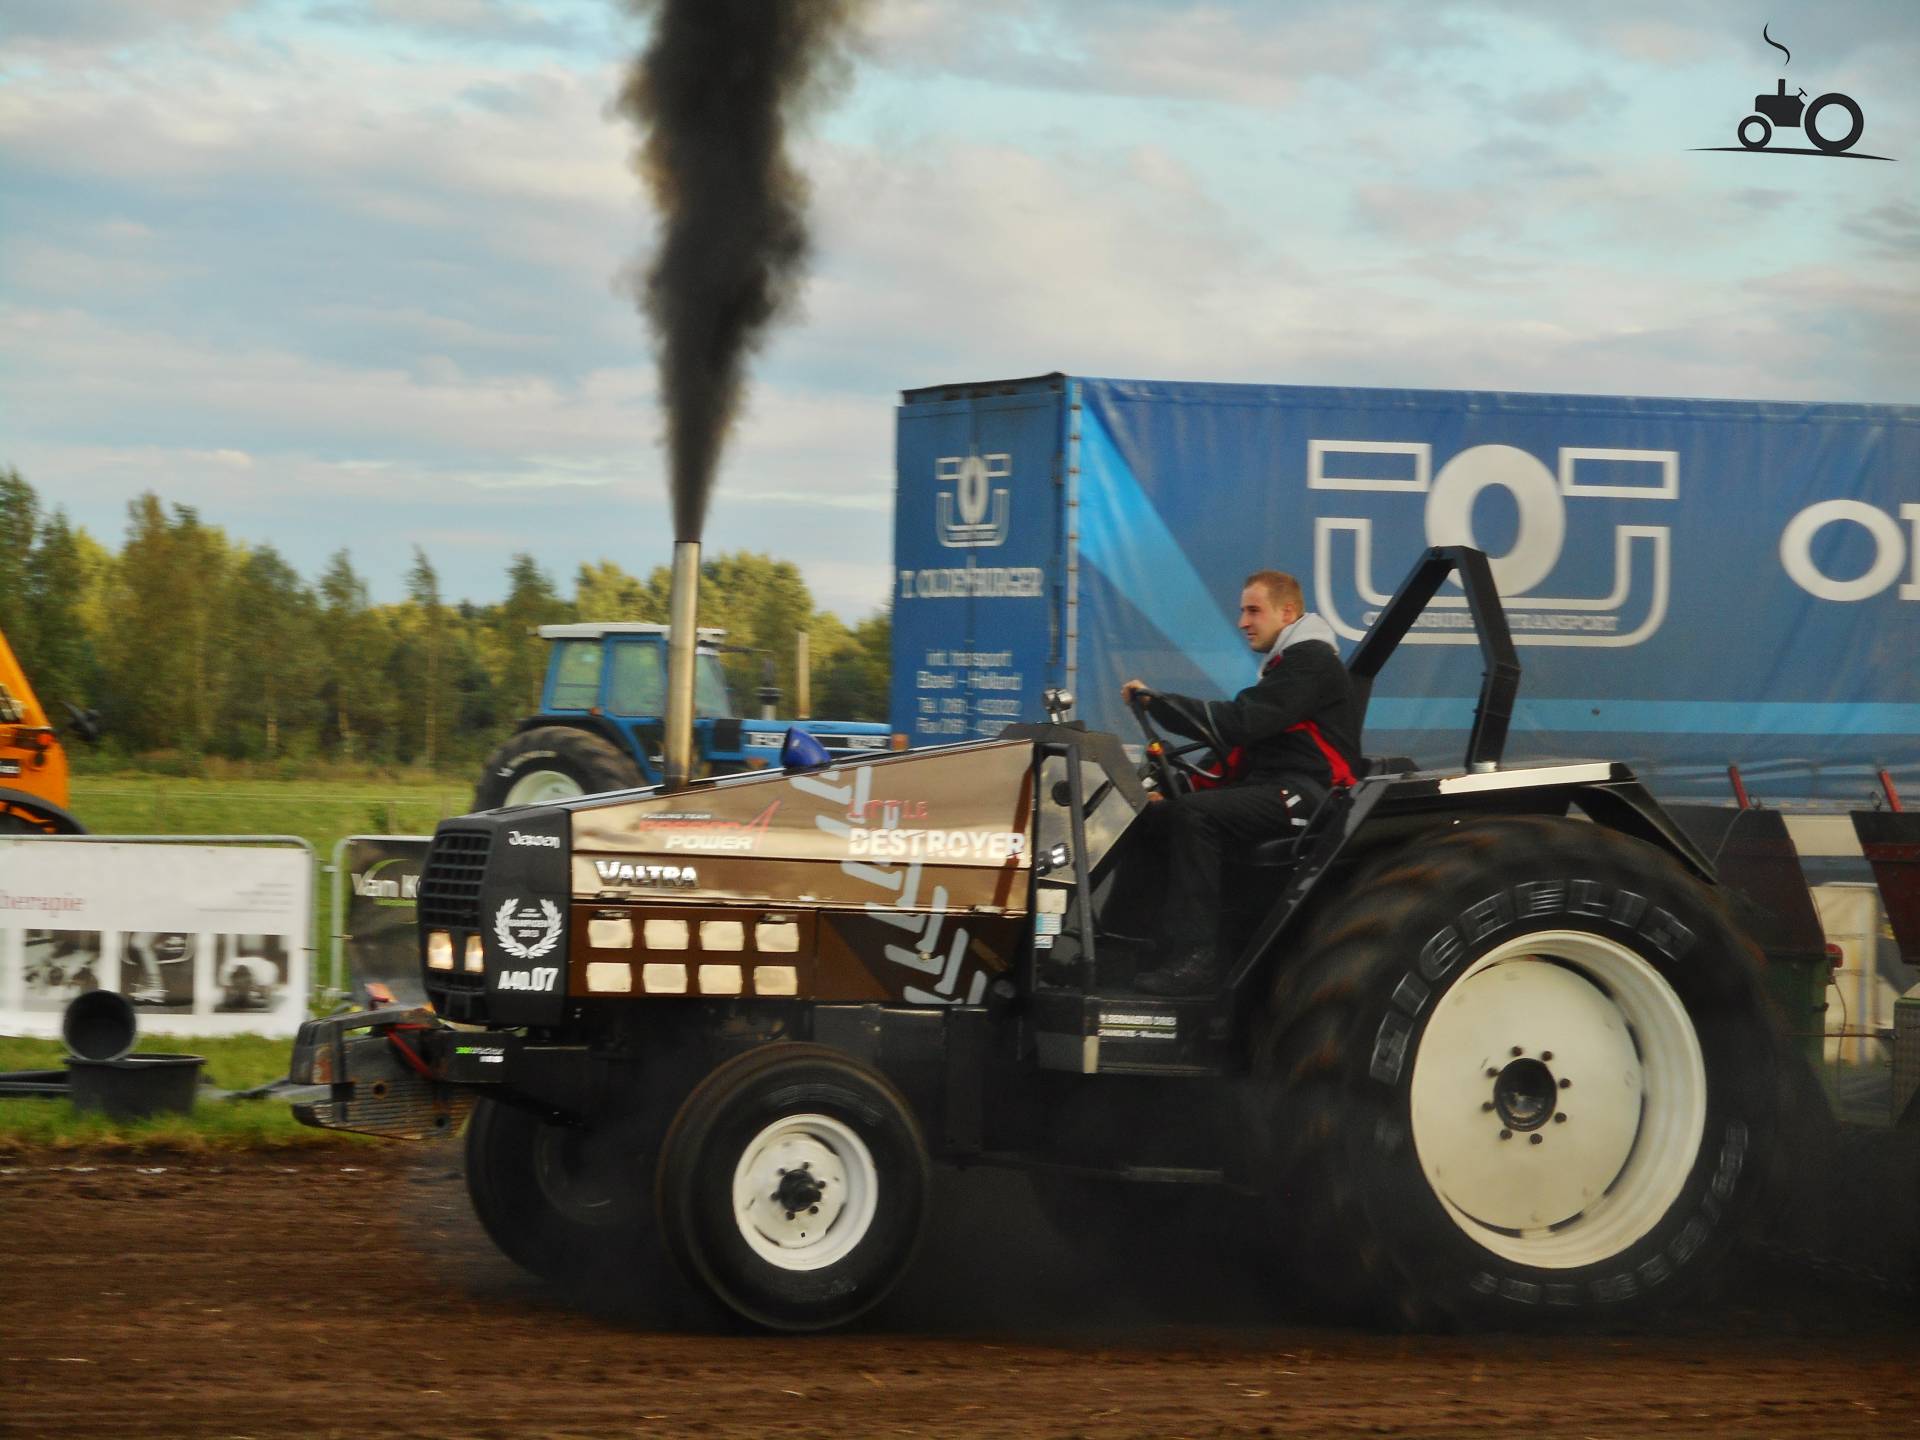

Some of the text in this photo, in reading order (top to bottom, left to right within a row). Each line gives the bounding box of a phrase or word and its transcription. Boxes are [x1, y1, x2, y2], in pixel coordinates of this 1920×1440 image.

[848, 800, 929, 820] LITTLE
[664, 834, 753, 850] POWER
[848, 828, 1027, 864] DESTROYER
[351, 874, 399, 897] Van
[595, 861, 698, 887] VALTRA
